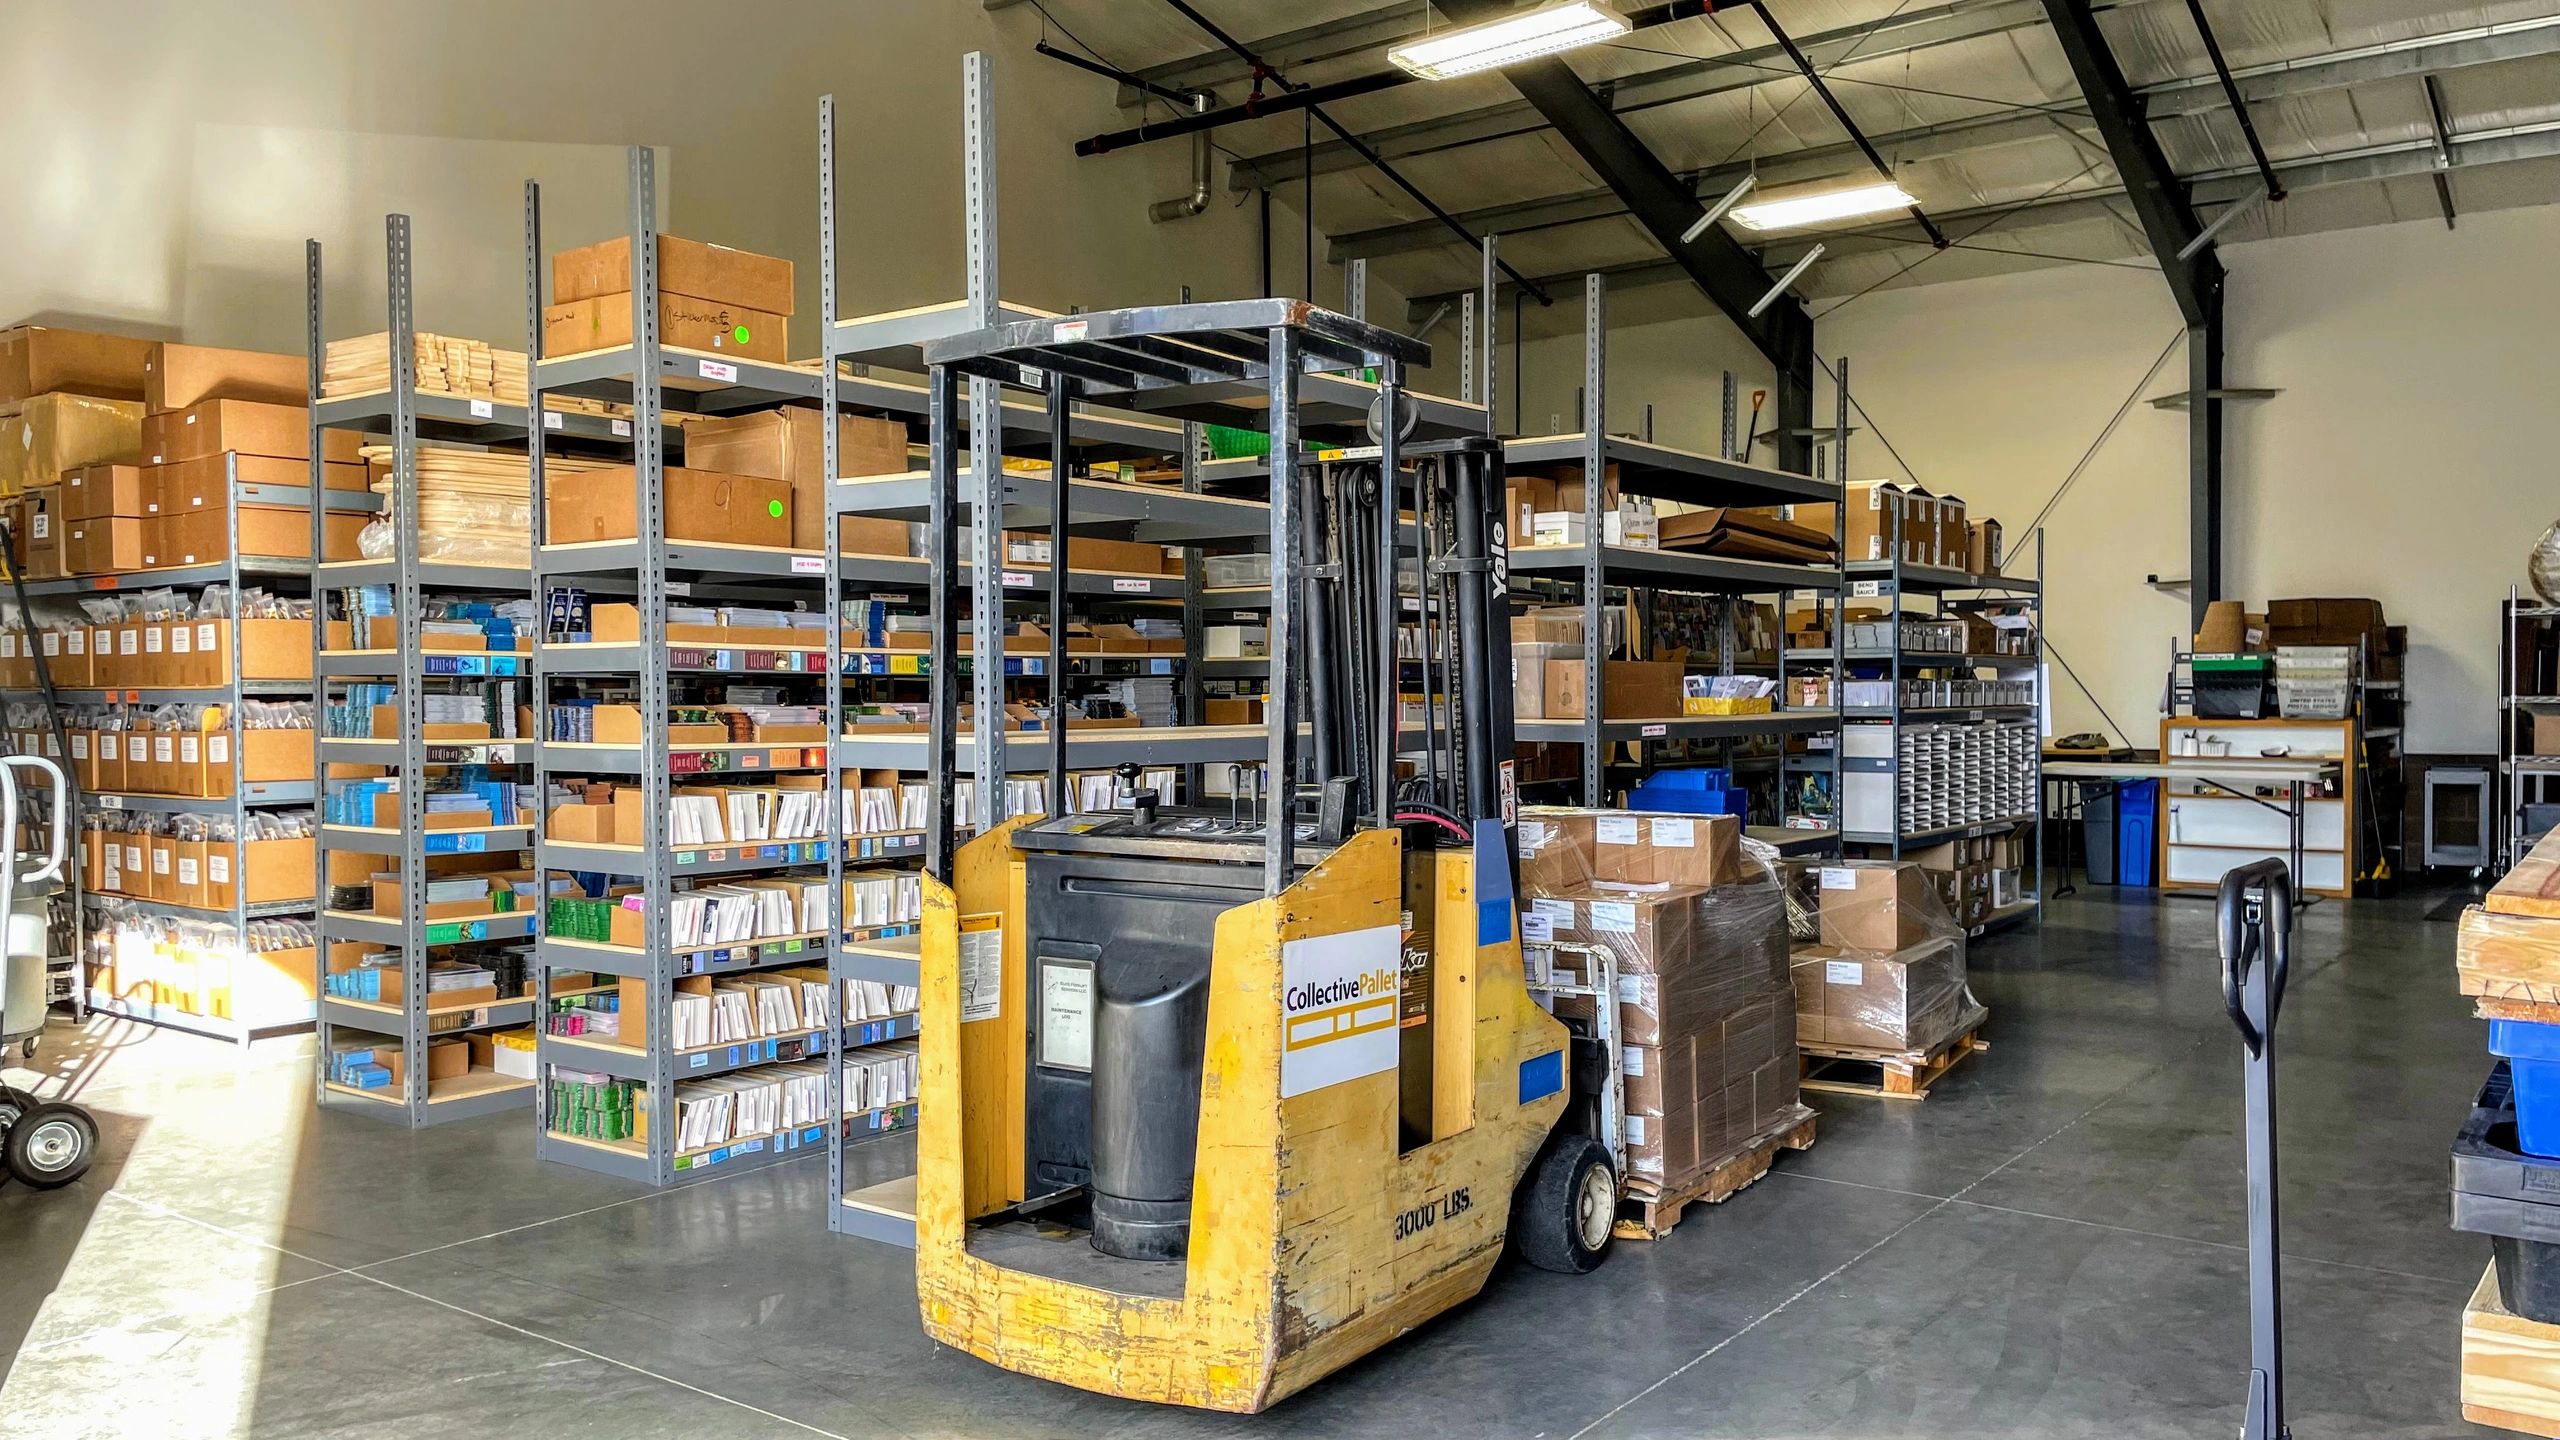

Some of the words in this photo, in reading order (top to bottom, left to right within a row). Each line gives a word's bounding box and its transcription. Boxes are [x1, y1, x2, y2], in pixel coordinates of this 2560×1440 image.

[1491, 521, 1507, 600] Yale
[1400, 947, 1428, 971] ka
[1287, 968, 1397, 1011] CollectivePallet
[1395, 1205, 1435, 1241] 3000
